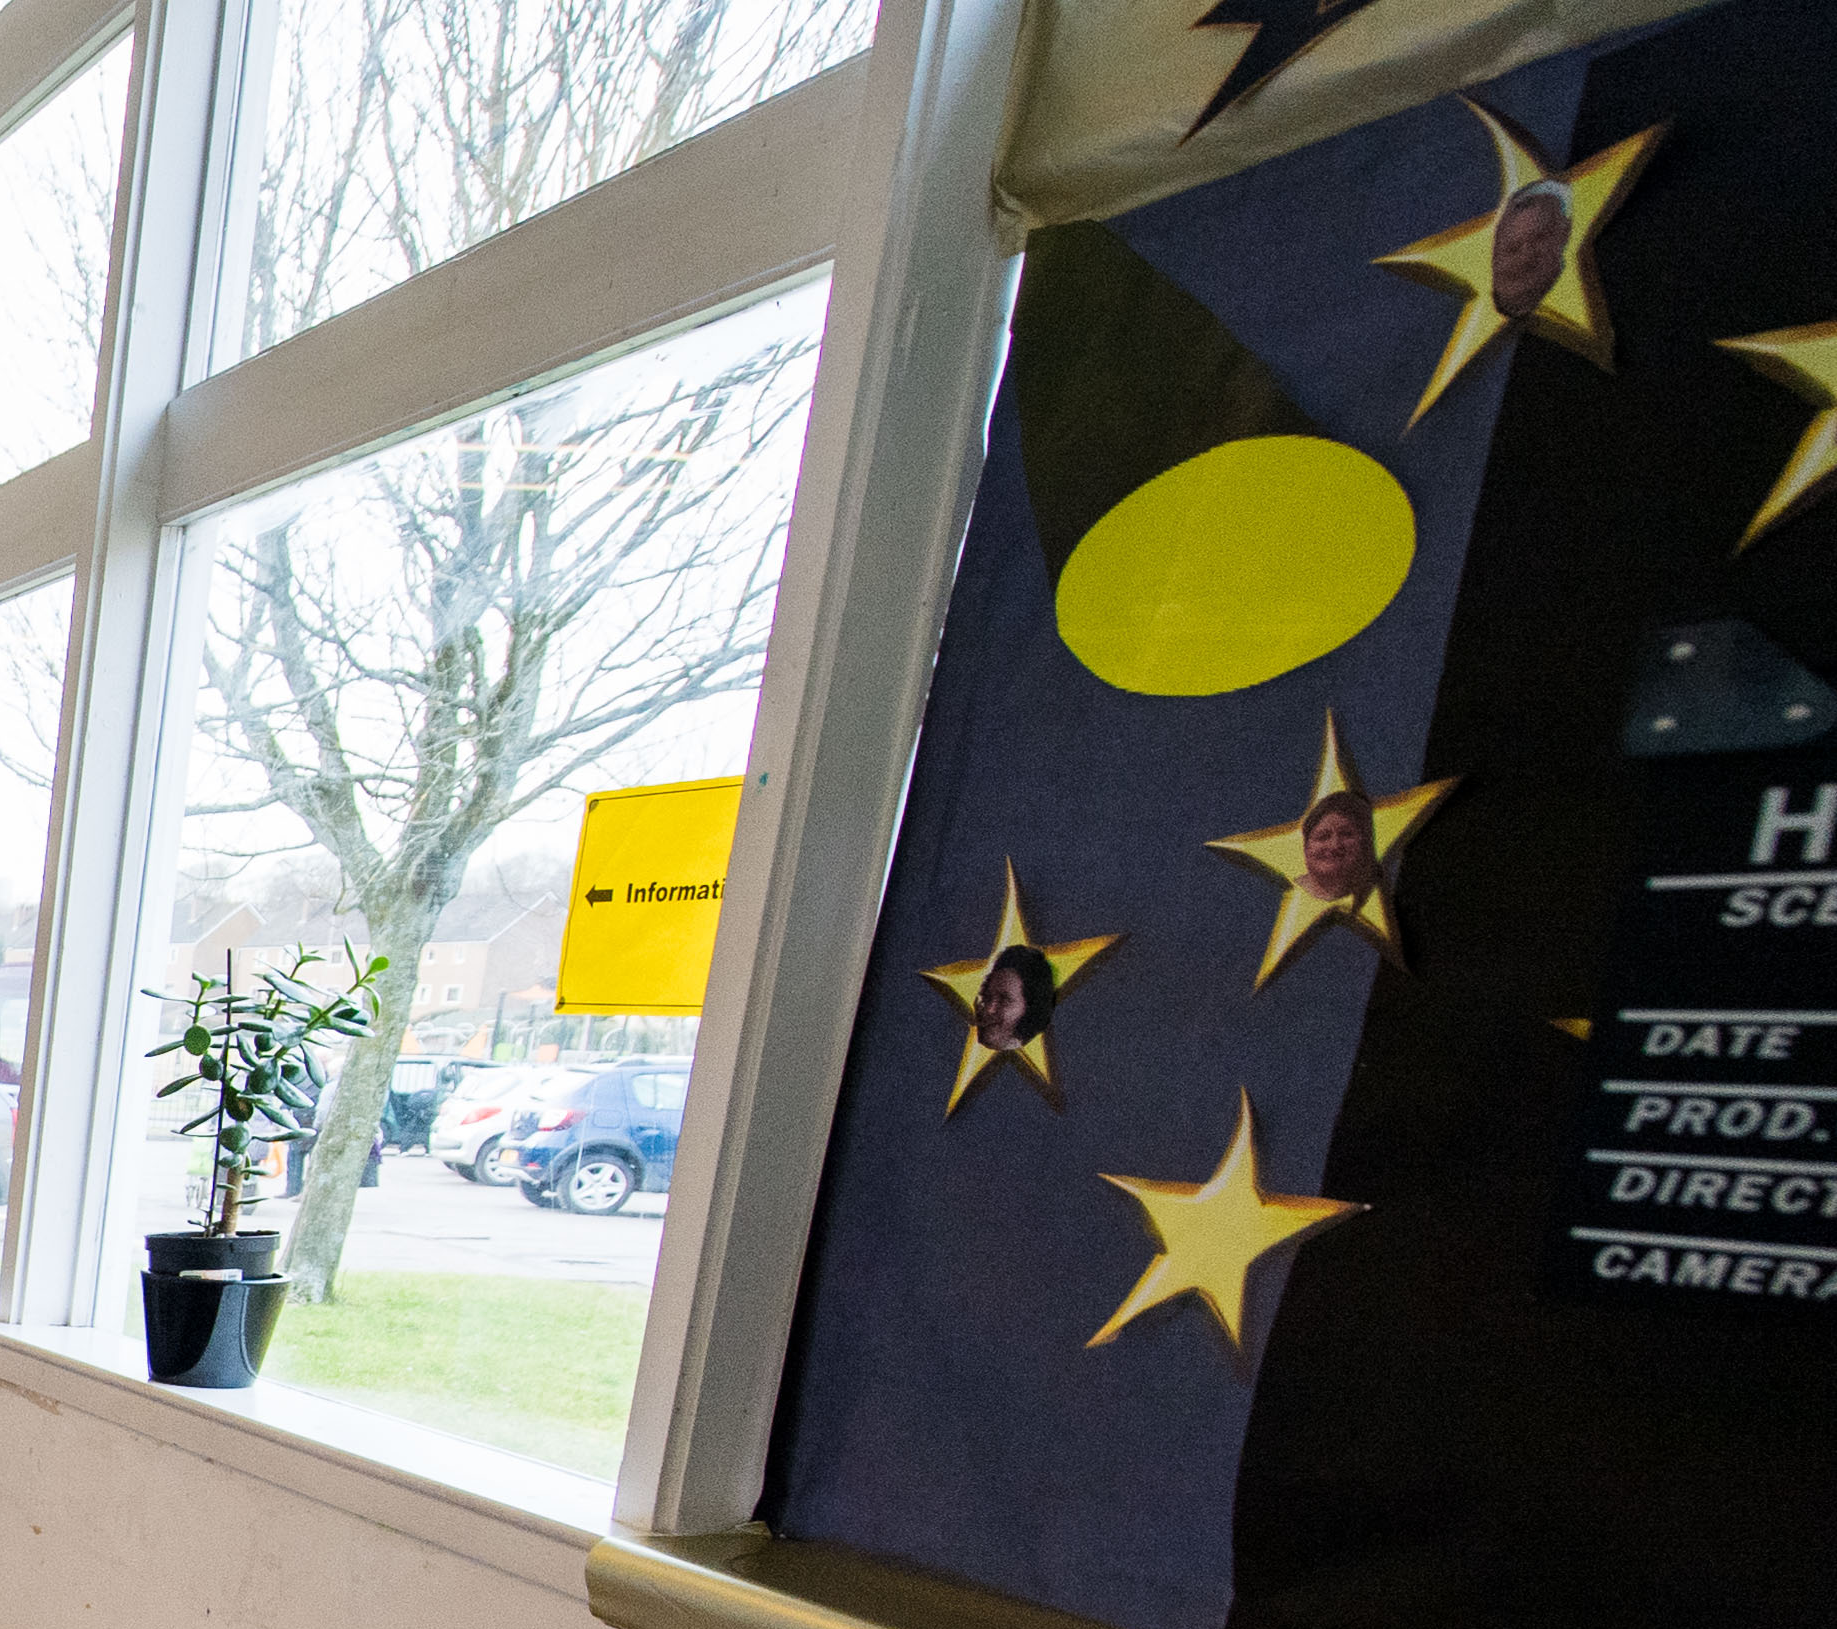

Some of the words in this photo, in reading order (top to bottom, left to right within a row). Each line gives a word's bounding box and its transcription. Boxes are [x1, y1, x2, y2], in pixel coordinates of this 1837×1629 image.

[625, 879, 726, 904] Informati
[1642, 1025, 1805, 1061] DATE
[1624, 1097, 1833, 1142] PROD.
